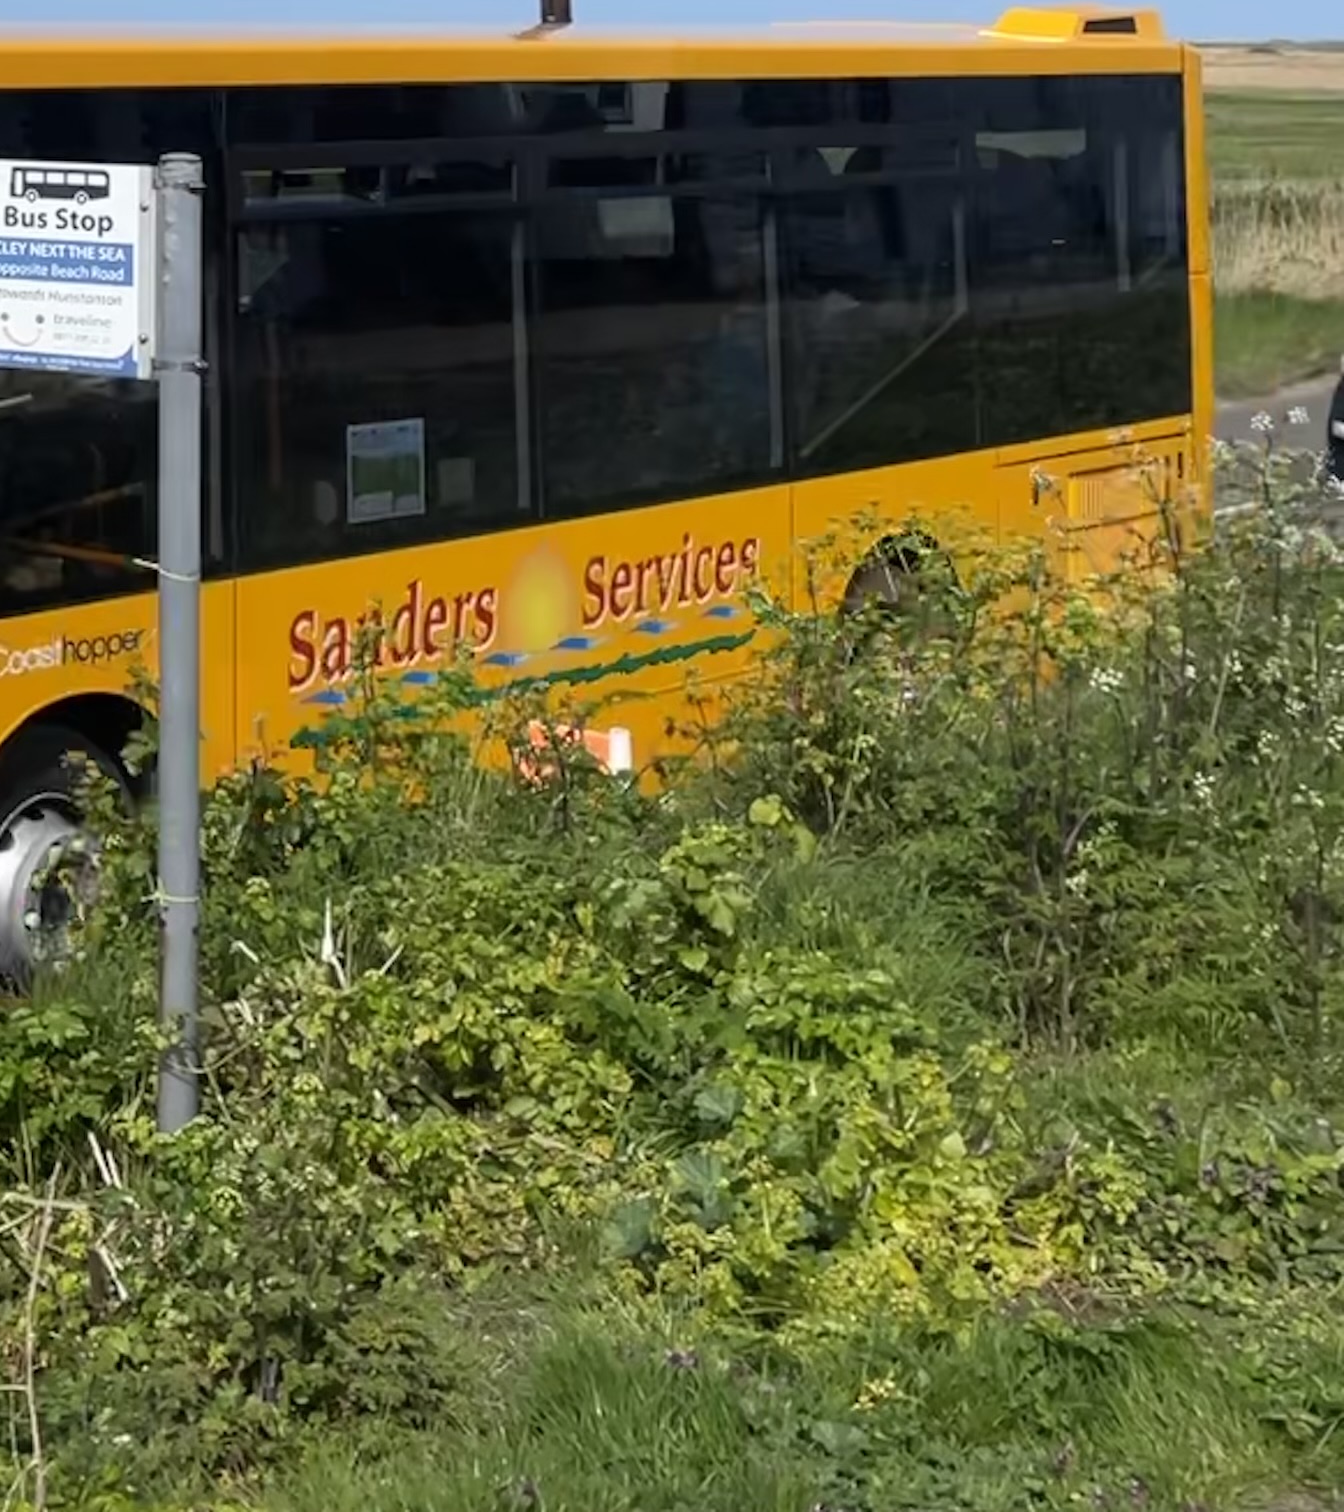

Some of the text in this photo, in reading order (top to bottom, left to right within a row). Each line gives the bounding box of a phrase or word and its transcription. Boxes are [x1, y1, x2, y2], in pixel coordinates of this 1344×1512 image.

[4, 205, 114, 238] Bus Stop
[29, 242, 66, 258] NEXT
[67, 244, 96, 260] THE
[98, 246, 126, 262] SEA
[50, 264, 90, 280] Beach
[91, 266, 125, 281] Road
[583, 533, 761, 631] Services
